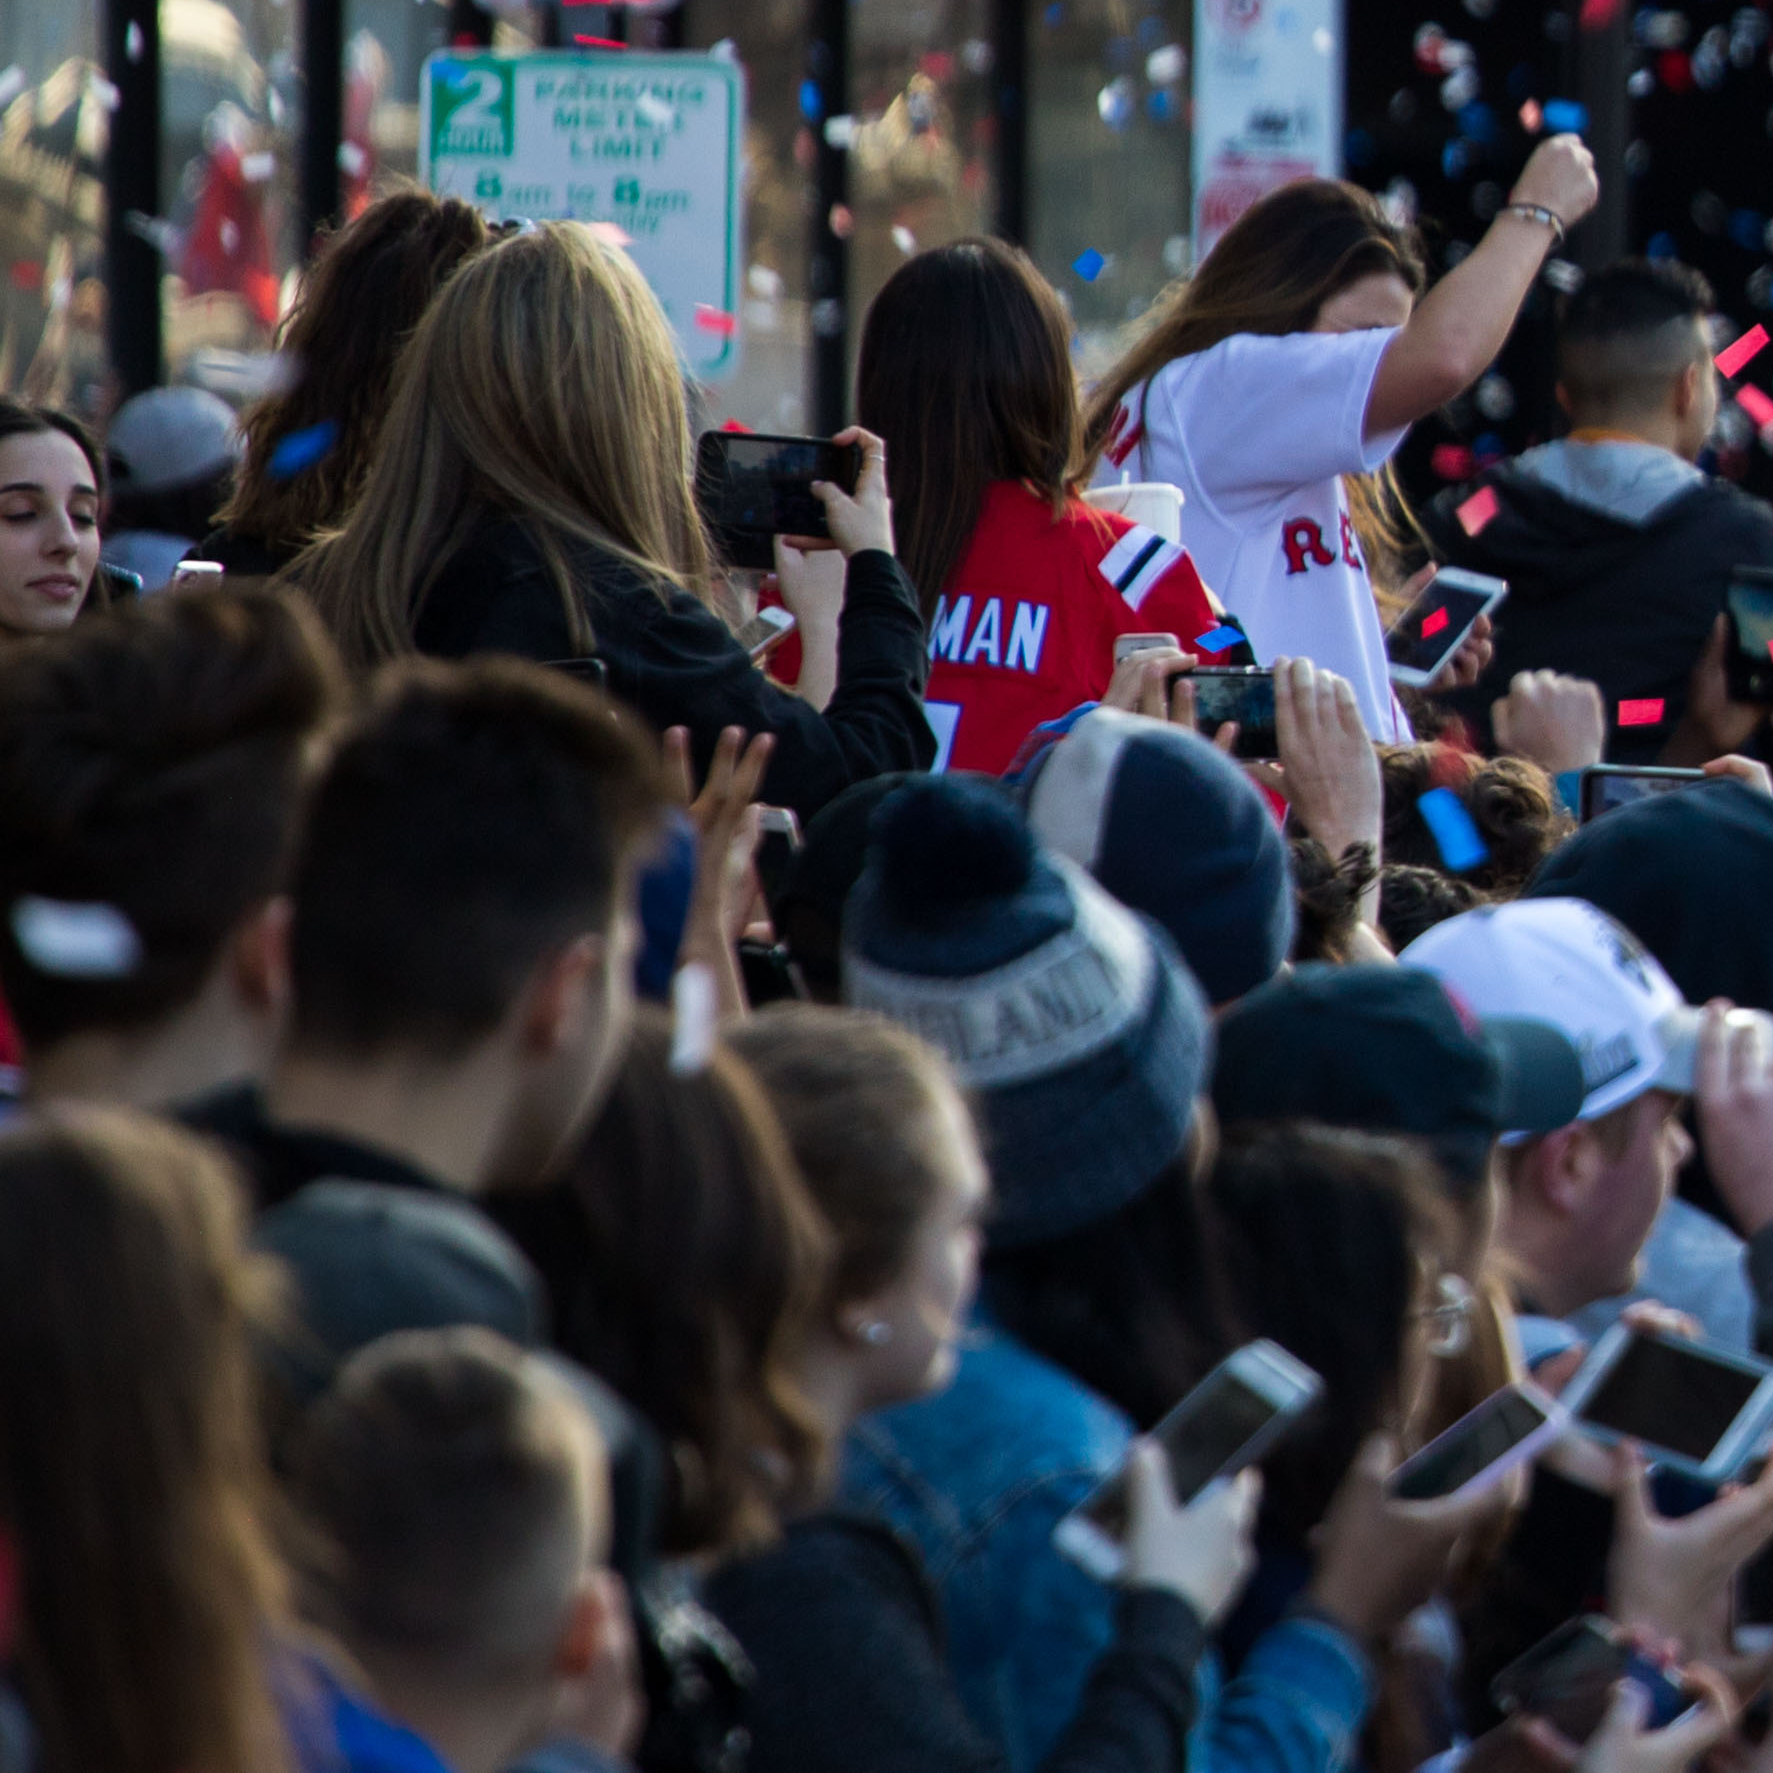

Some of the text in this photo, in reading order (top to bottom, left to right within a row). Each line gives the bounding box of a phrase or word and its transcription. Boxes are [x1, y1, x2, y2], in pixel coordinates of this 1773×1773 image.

[446, 68, 504, 125] 2
[533, 76, 705, 106] PARKING
[573, 132, 667, 164] LIMIT
